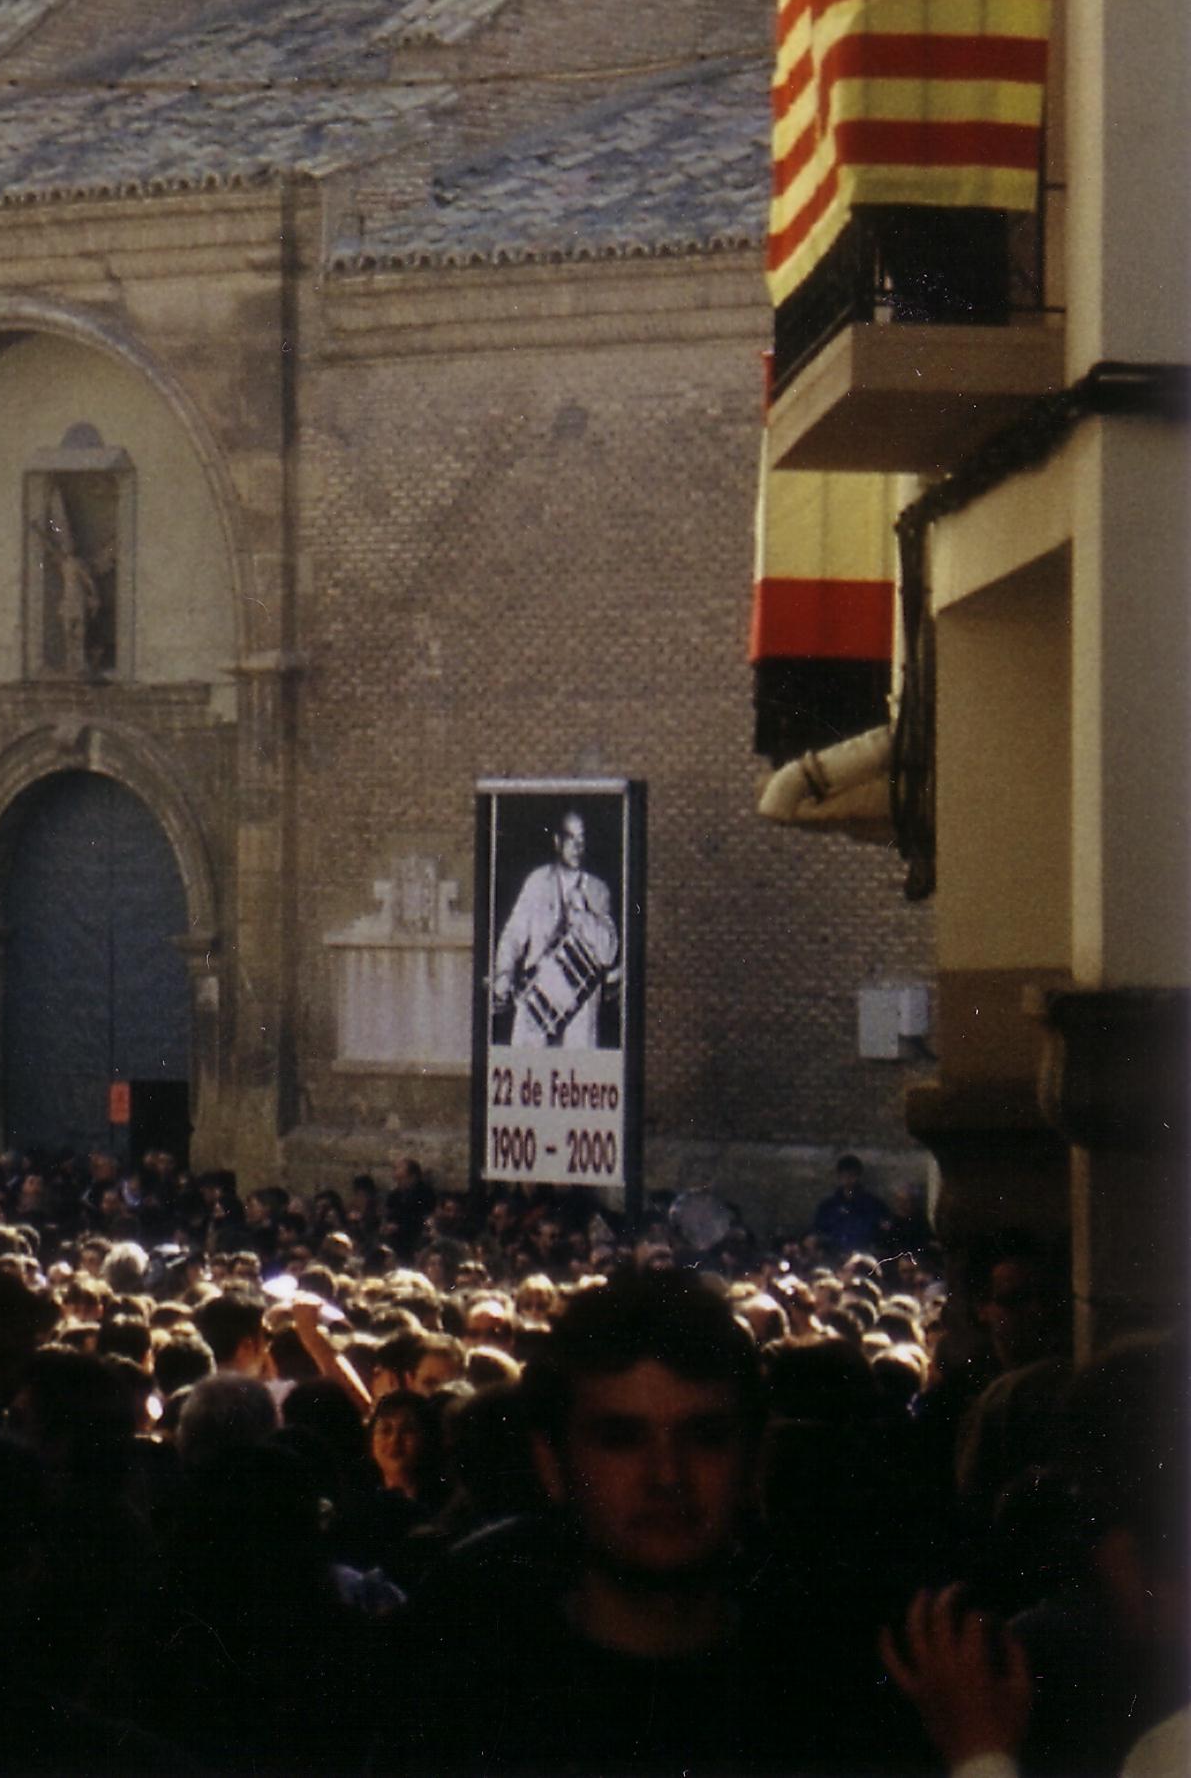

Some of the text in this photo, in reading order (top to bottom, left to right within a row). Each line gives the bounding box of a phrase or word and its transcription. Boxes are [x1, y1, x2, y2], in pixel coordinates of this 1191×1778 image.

[492, 1068, 618, 1110] 22 de Febrero
[492, 1126, 536, 1170] 1900
[566, 1129, 616, 1174] 2000
